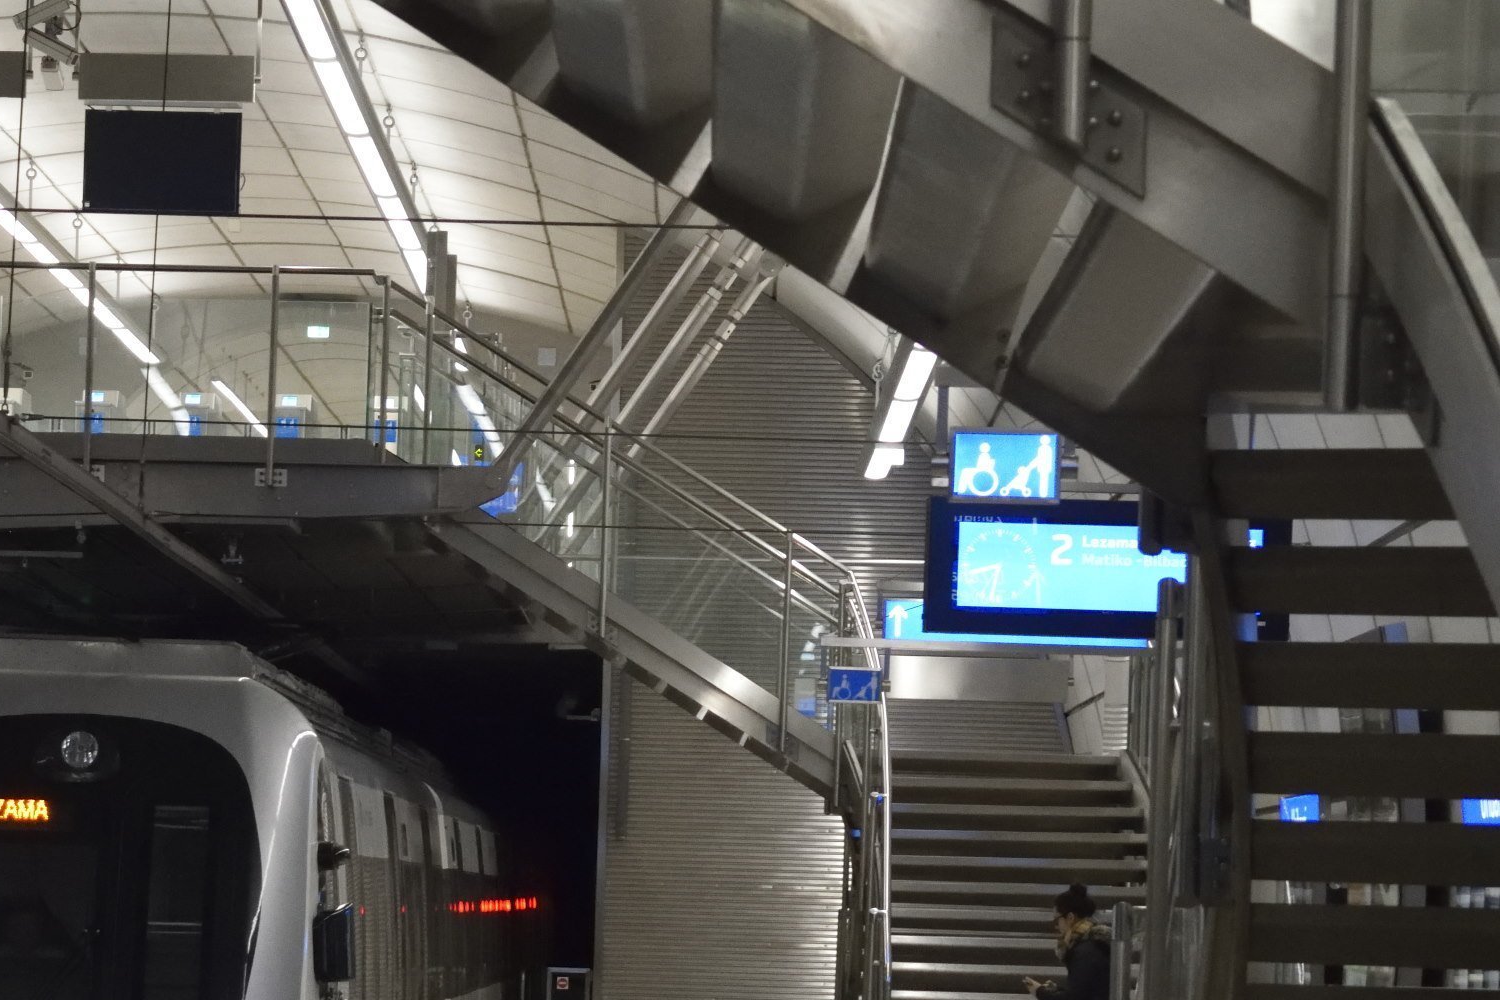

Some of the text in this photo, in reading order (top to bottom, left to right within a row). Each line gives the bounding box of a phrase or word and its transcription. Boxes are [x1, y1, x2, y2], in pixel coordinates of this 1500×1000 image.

[1050, 533, 1139, 566] 2 Lezama
[1081, 554, 1133, 567] Matiko
